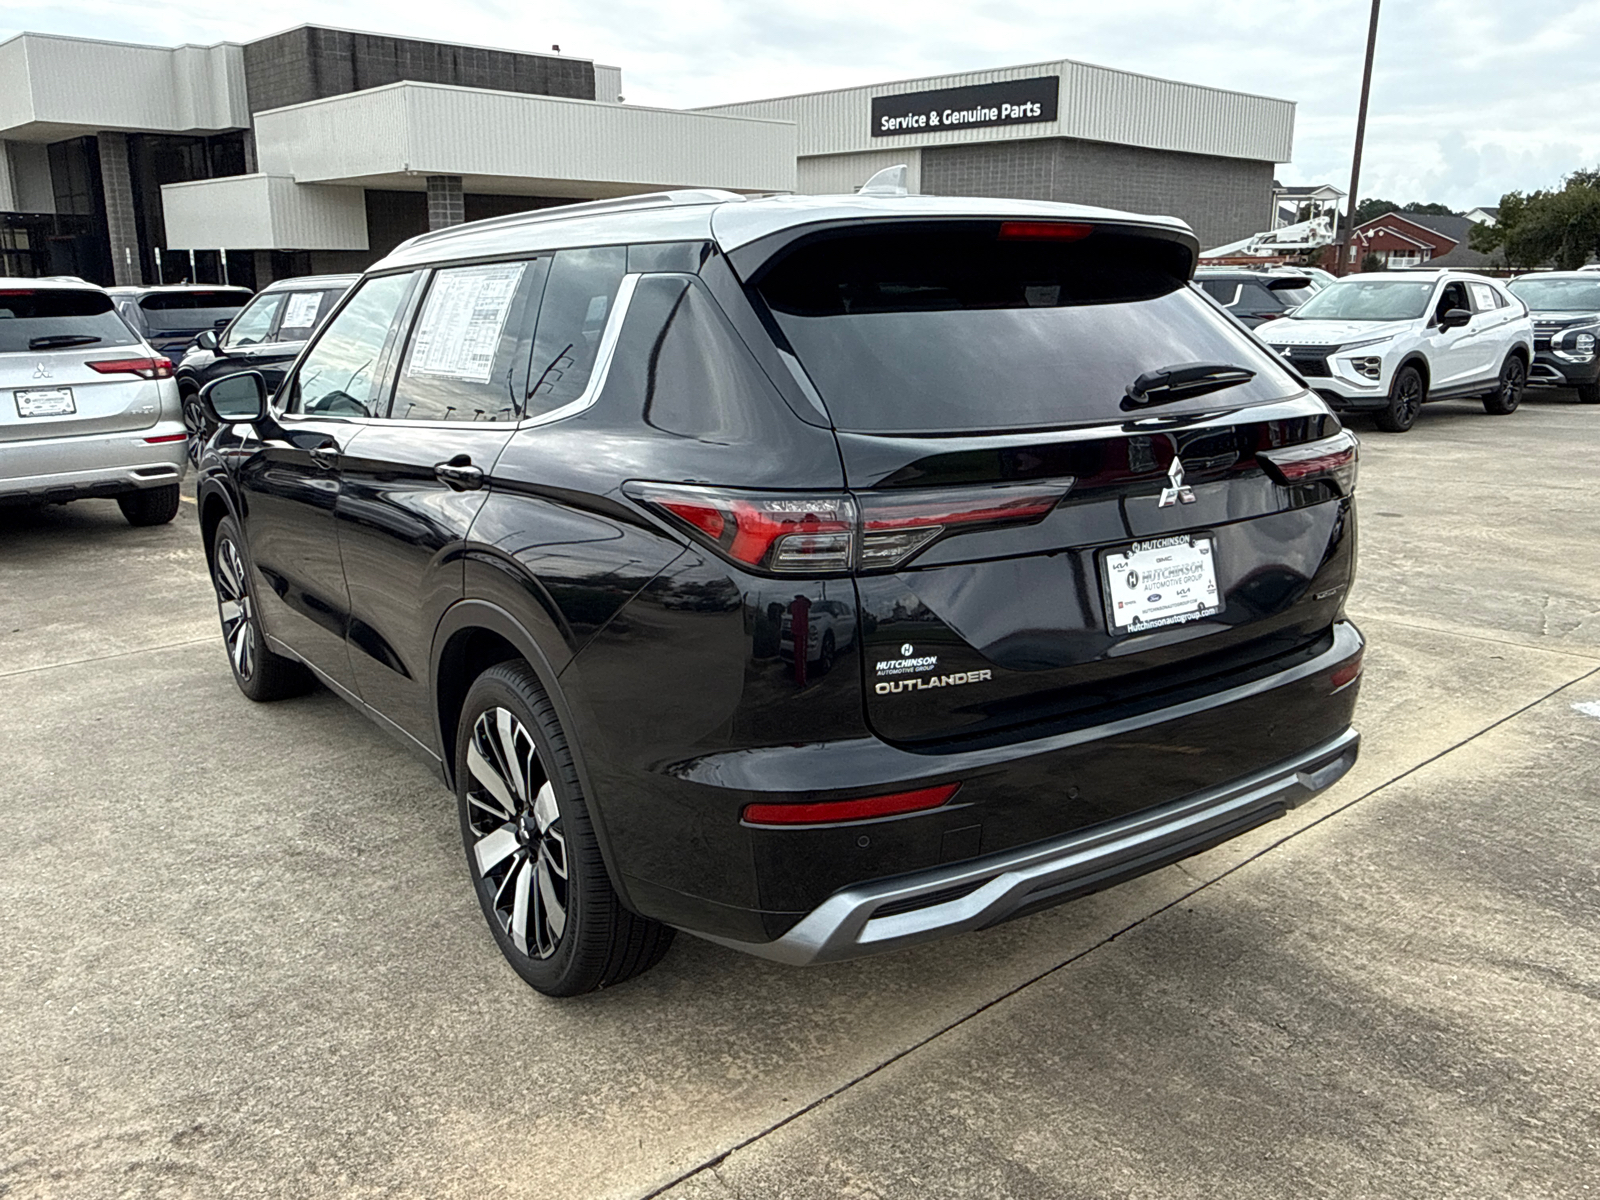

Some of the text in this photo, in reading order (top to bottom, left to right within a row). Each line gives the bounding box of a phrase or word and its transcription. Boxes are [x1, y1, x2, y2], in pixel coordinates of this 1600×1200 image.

[881, 101, 1041, 131] Service & Genuine Parts
[1142, 534, 1190, 551] HUTCHINSON
[1142, 560, 1204, 583] HUTCHINSON
[1144, 574, 1203, 591] AUTOMOTIVE GROUP
[1127, 607, 1216, 633] Hutchinsonautogroup.com
[876, 656, 937, 671] HUTCHINSON
[877, 665, 935, 676] AUTOMOTIVE GROUP
[875, 669, 992, 695] OUTLANDER
